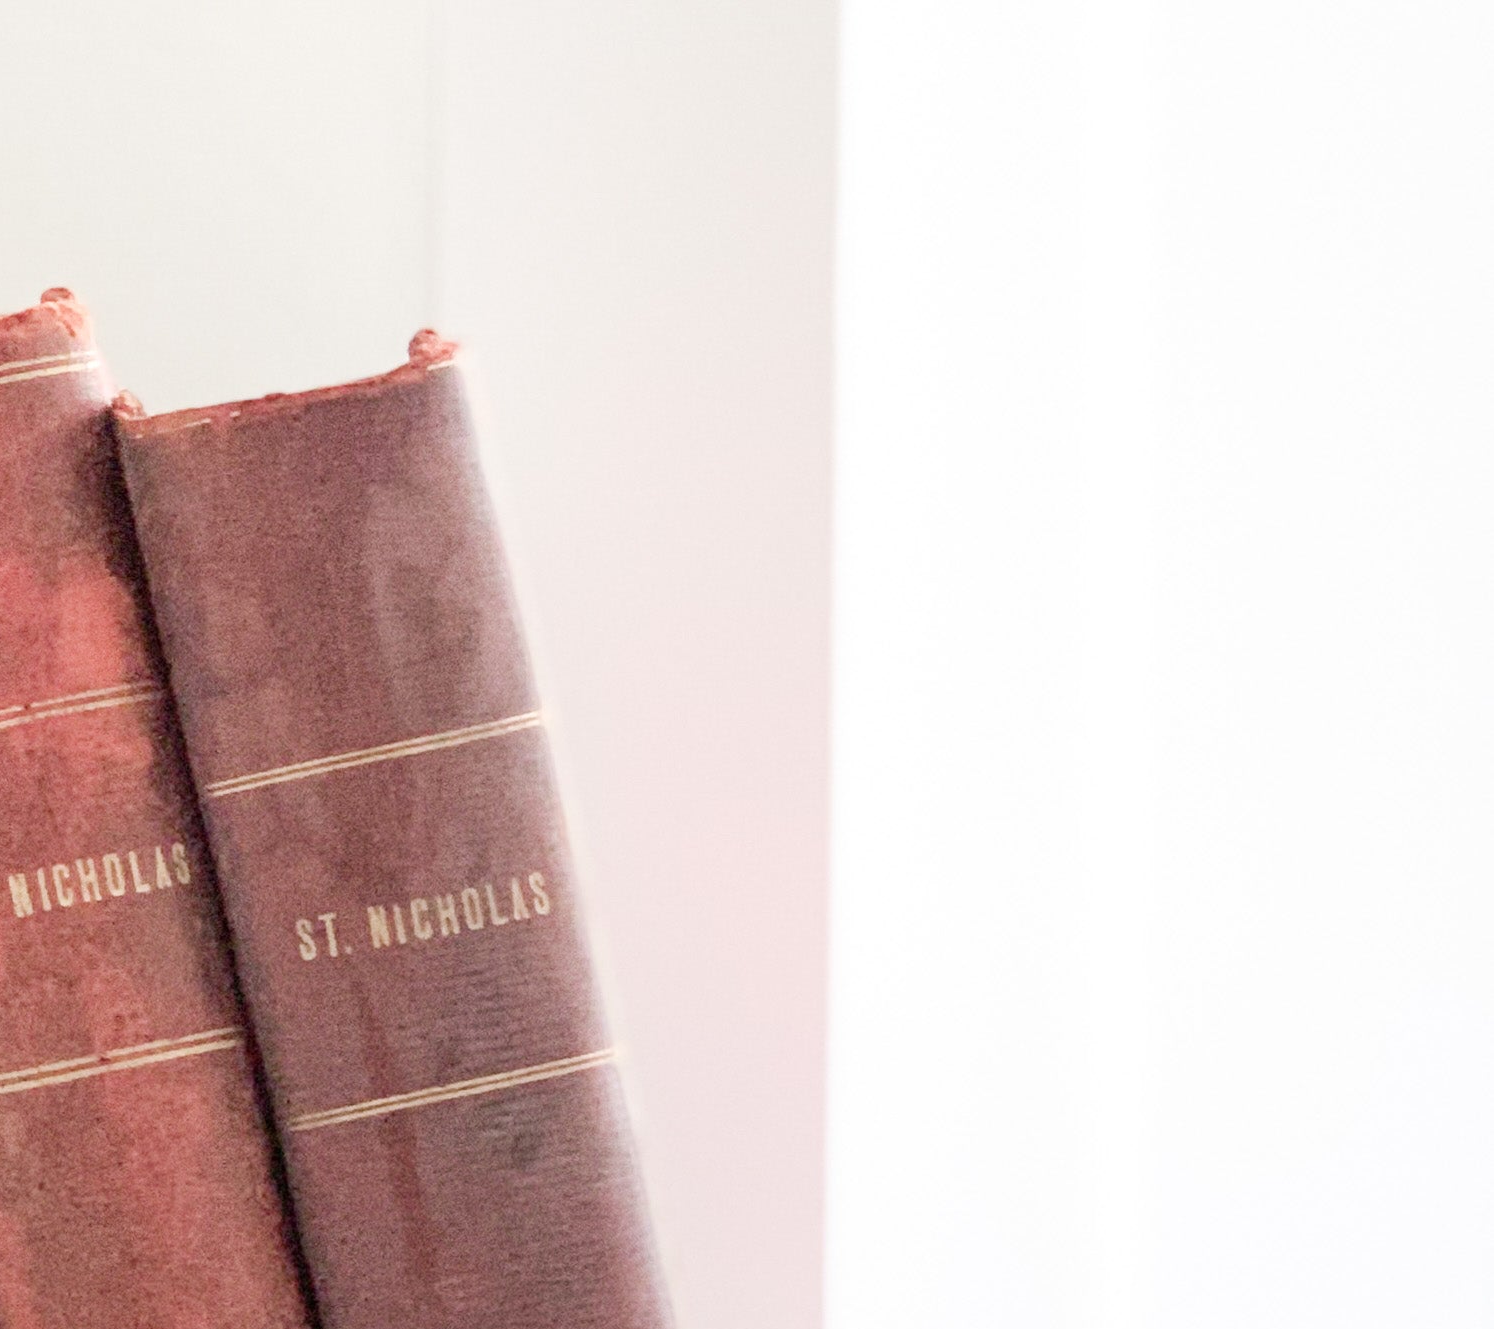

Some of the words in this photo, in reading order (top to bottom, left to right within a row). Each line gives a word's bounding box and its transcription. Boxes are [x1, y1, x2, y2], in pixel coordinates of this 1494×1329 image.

[7, 840, 192, 919] NICHOLAS
[295, 911, 353, 962] ST.
[366, 871, 551, 950] NICHOLAS
